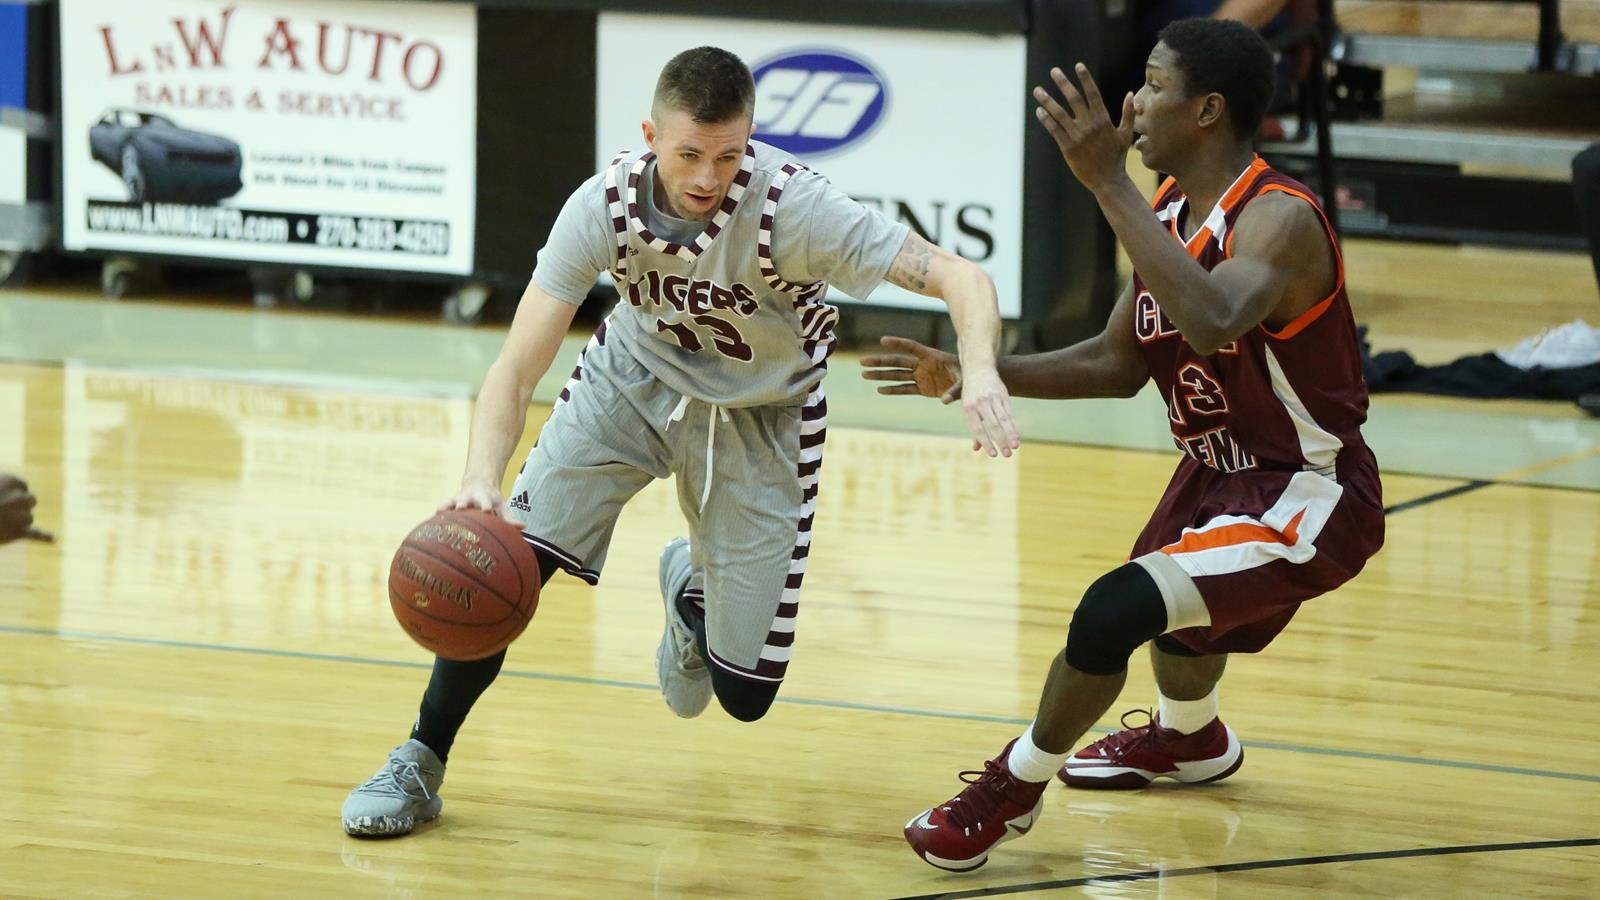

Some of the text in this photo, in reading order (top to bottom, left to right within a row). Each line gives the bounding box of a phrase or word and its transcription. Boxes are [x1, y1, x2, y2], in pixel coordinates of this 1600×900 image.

[258, 17, 444, 92] AUTO
[134, 82, 405, 120] SALES & SERVICE
[627, 269, 760, 319] TIGERS
[656, 314, 754, 363] 13
